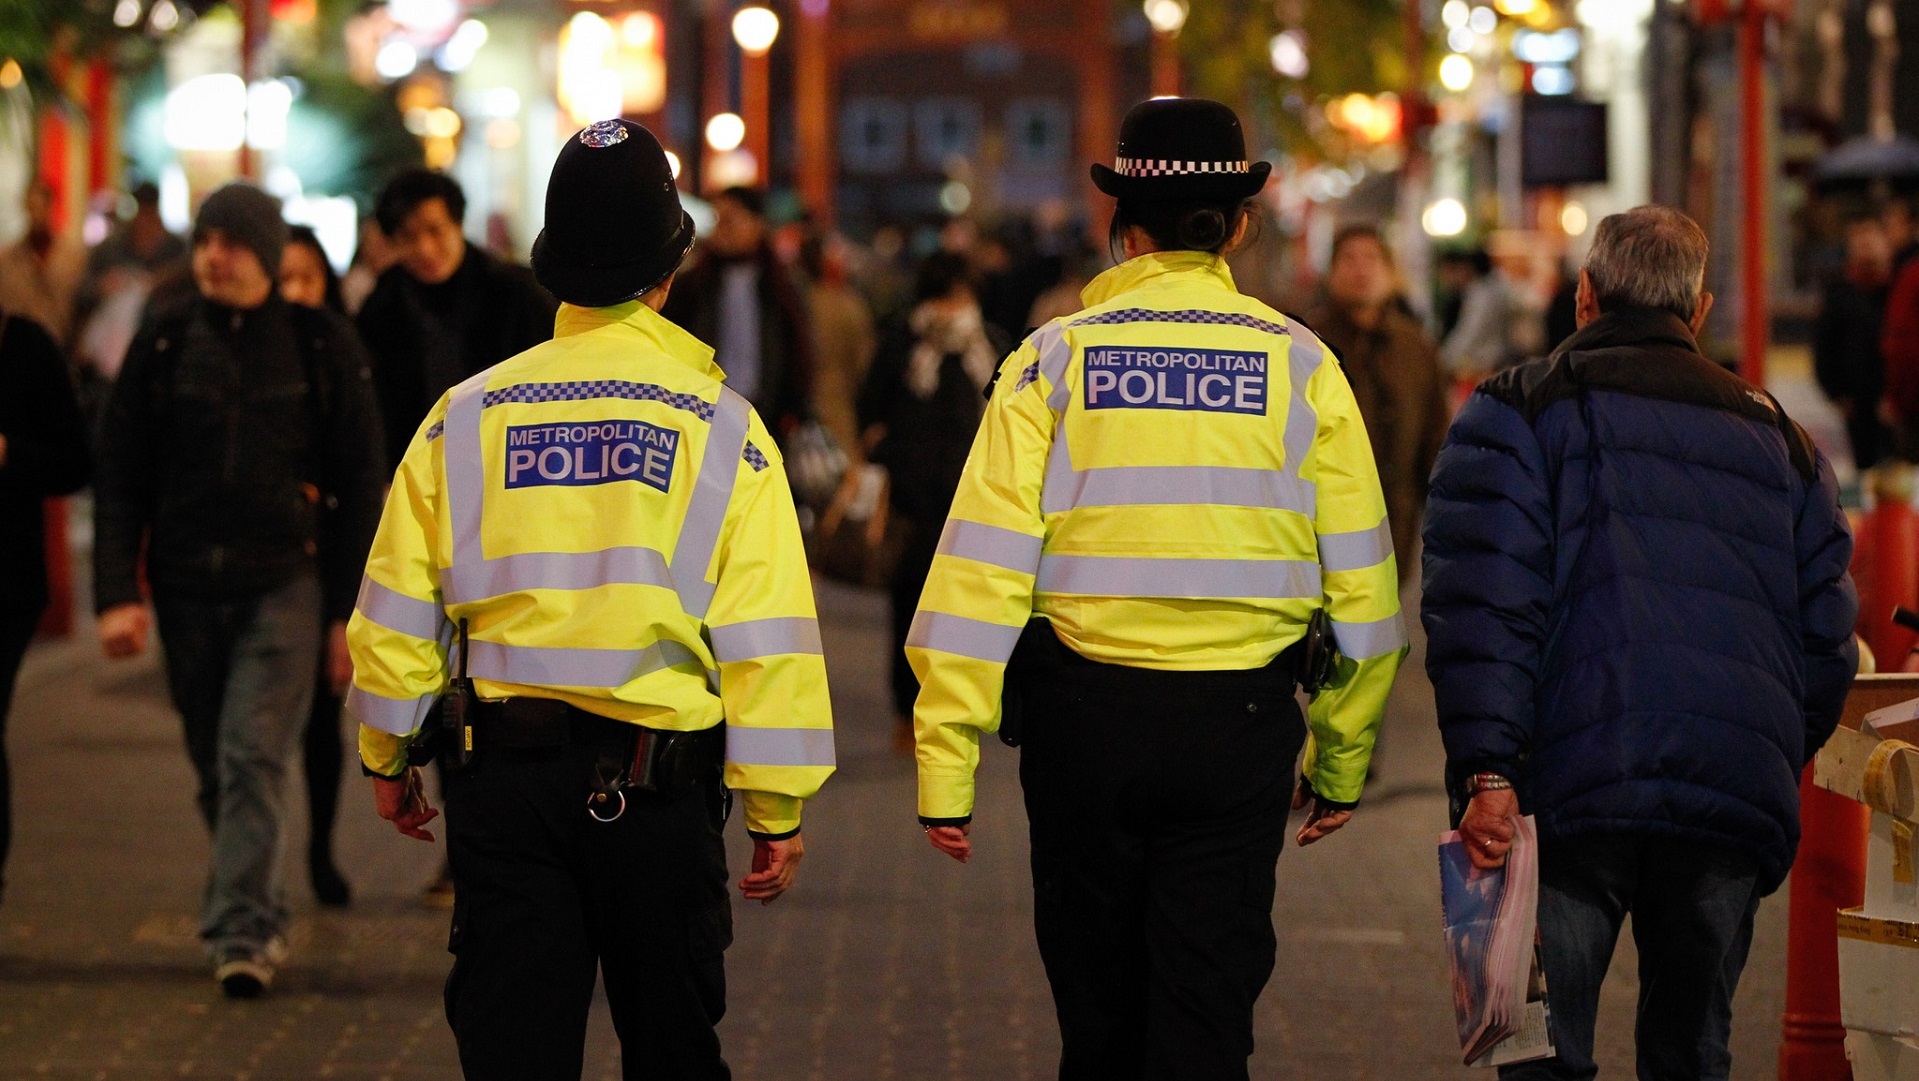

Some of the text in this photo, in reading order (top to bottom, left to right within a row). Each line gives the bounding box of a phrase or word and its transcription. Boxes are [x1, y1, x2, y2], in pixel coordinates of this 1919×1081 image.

[1088, 351, 1264, 372] METROPOLITAN
[1088, 369, 1263, 409] POLICE
[510, 424, 675, 450] METROPOLITAN
[509, 443, 671, 486] POLICE
